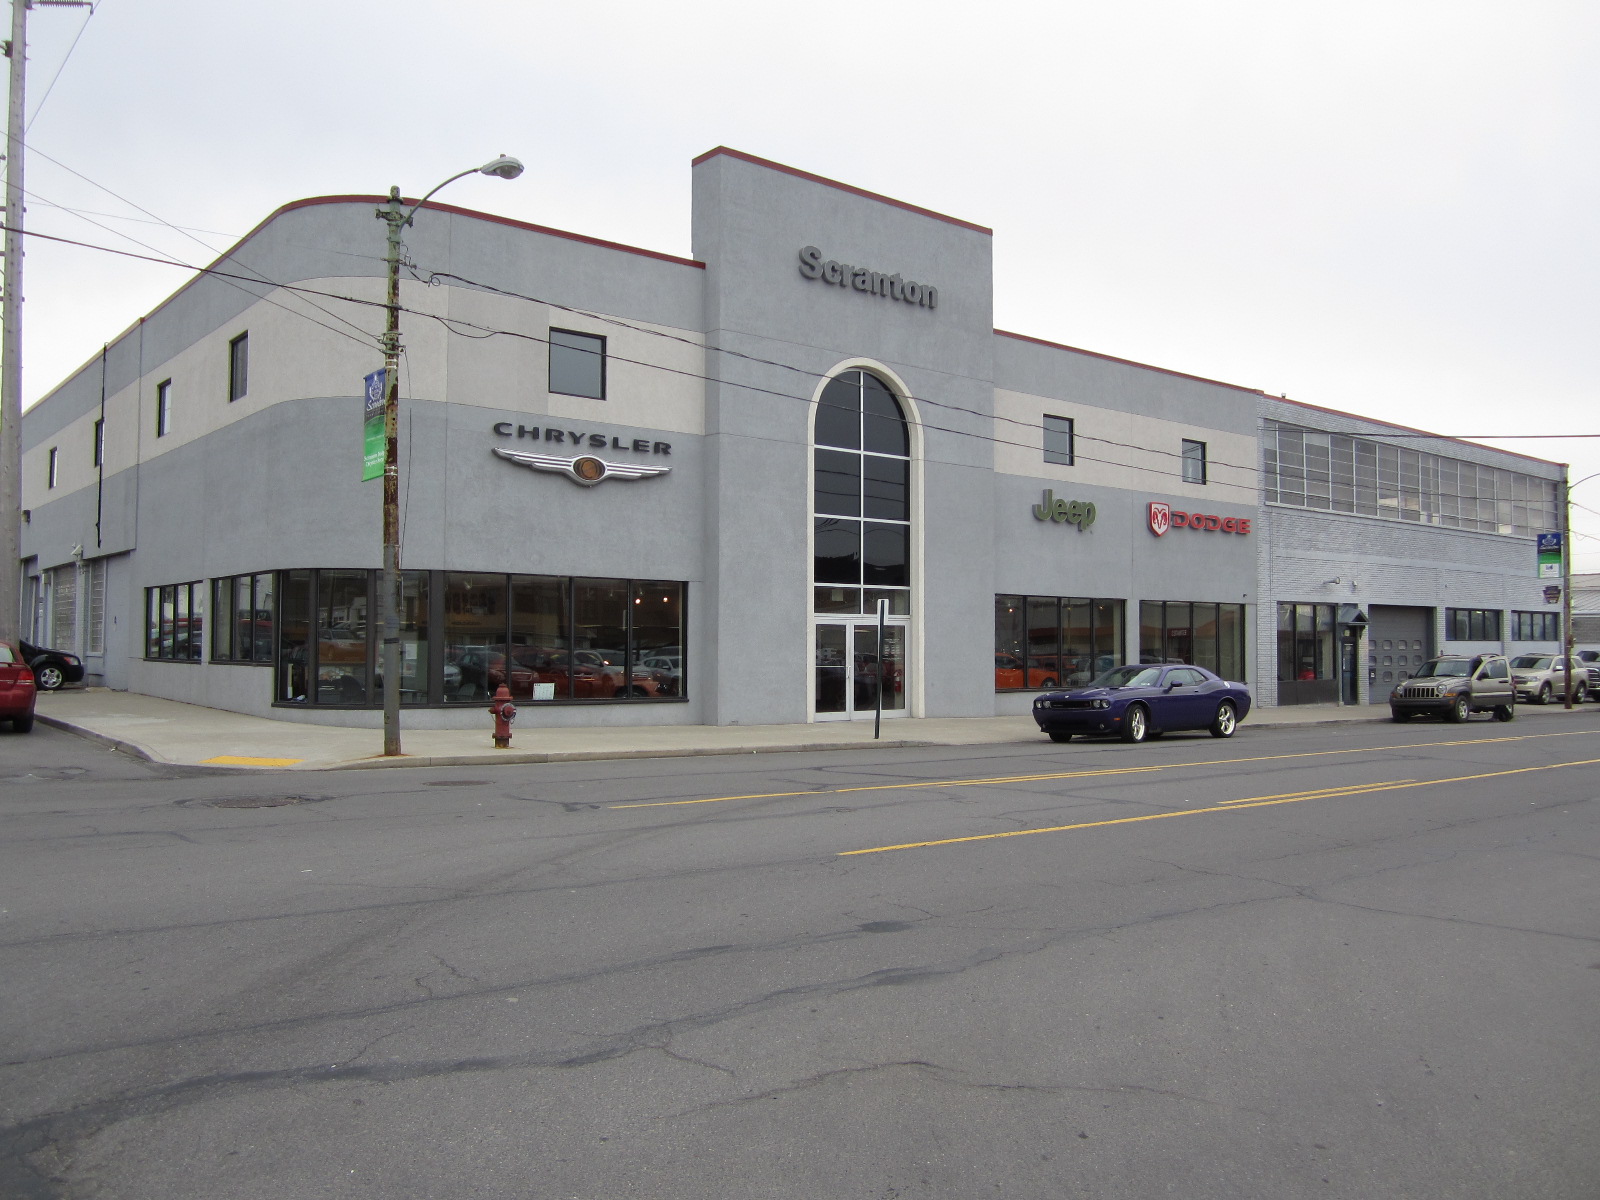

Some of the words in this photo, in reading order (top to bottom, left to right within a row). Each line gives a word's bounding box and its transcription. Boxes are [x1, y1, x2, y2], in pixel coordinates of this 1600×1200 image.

[798, 245, 939, 309] Scranton
[493, 422, 672, 455] CHRYSLER
[1032, 489, 1096, 531] Jeep
[1171, 511, 1251, 534] DODGE
